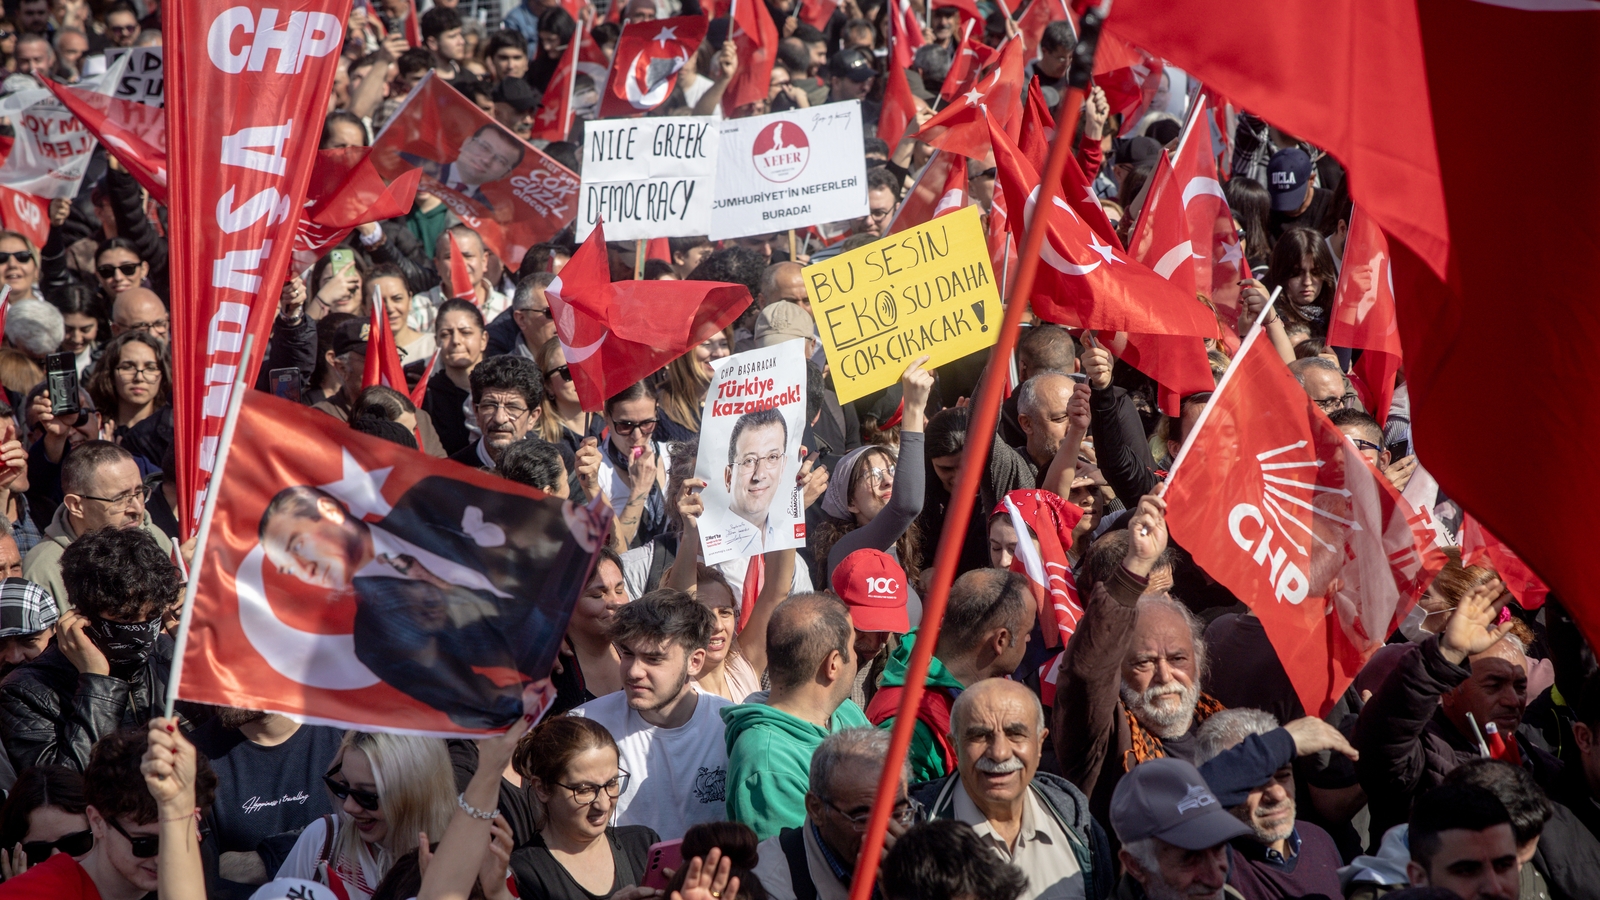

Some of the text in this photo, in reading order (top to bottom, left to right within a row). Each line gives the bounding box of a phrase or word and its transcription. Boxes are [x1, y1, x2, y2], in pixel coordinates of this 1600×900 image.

[207, 5, 342, 75] CHP
[591, 123, 709, 162] NICE GREEK
[763, 152, 801, 168] NEFER
[801, 176, 858, 196] NEFERLERİ
[1272, 171, 1297, 184] UCLA
[14, 192, 41, 231] CHP
[510, 175, 570, 220] GÜZEL
[512, 189, 550, 219] olacak
[587, 180, 695, 225] DEMOCRACY
[762, 205, 811, 221] BURADA!
[811, 225, 949, 303] BU SESİN
[935, 262, 989, 302] DAHA
[721, 357, 777, 379] CHP BAŞARACAK
[841, 343, 886, 381] ÇOK
[712, 384, 801, 417] kazanacak!
[718, 376, 774, 399] Türkiye
[1228, 503, 1310, 605] CHP
